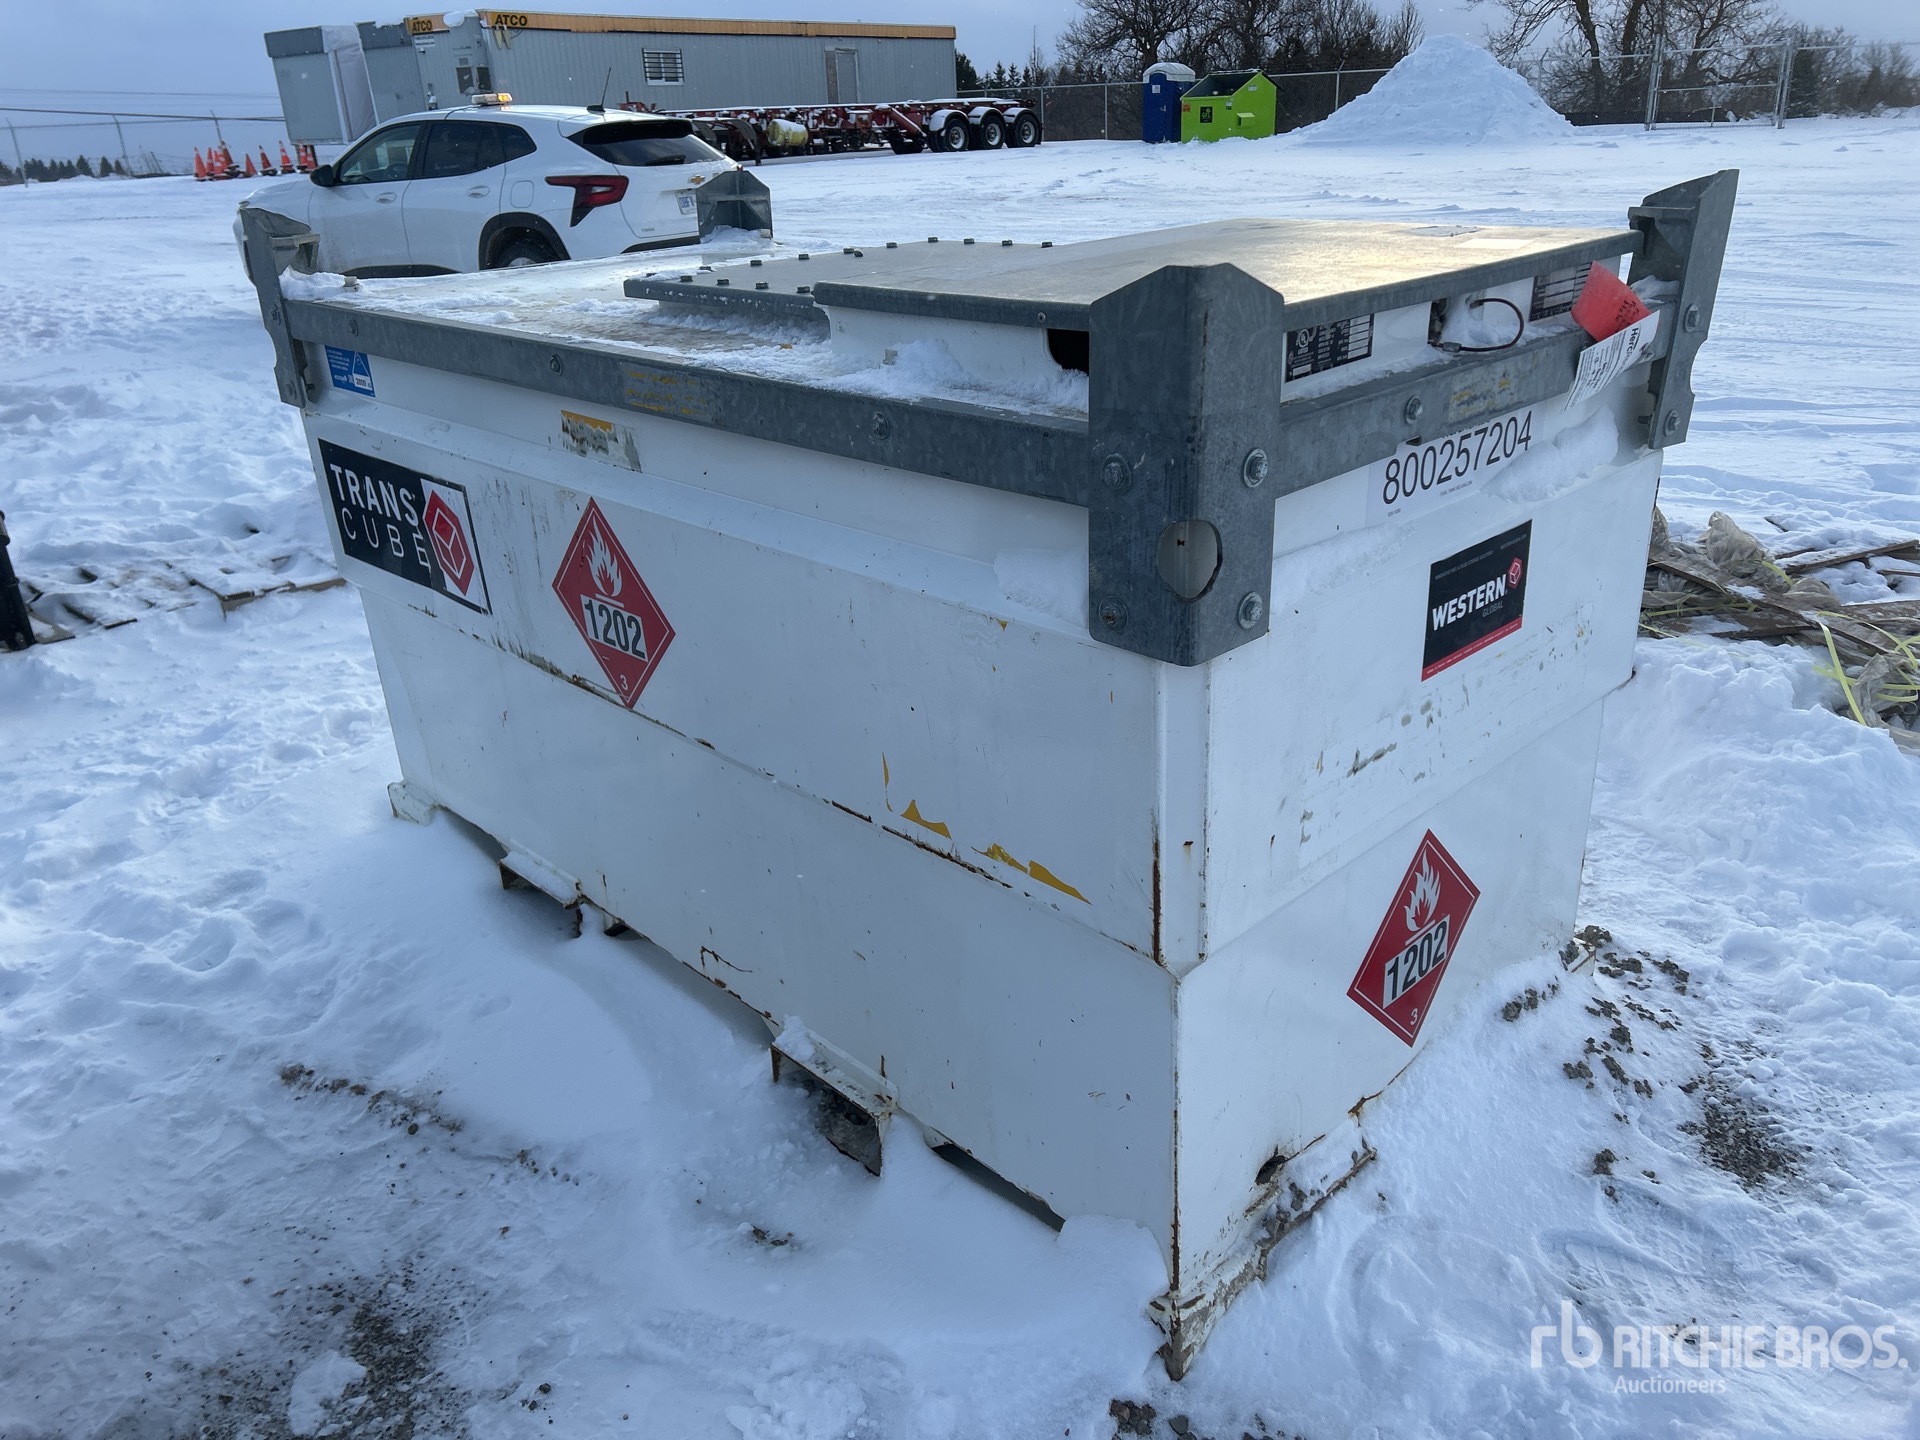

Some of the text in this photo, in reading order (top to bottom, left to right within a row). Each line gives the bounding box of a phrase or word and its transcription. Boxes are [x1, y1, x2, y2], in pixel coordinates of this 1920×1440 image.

[411, 20, 433, 32] ATCO
[494, 14, 528, 26] ATCO
[1382, 410, 1532, 505] 800257204
[329, 463, 419, 527] TRANS
[341, 506, 432, 570] CUBE
[584, 599, 646, 660] 1202
[1432, 573, 1507, 632] WESTERN
[1482, 600, 1504, 618] GLOBAL
[620, 674, 629, 691] 3
[1387, 920, 1447, 1001] 1202
[1410, 1007, 1418, 1025] 3
